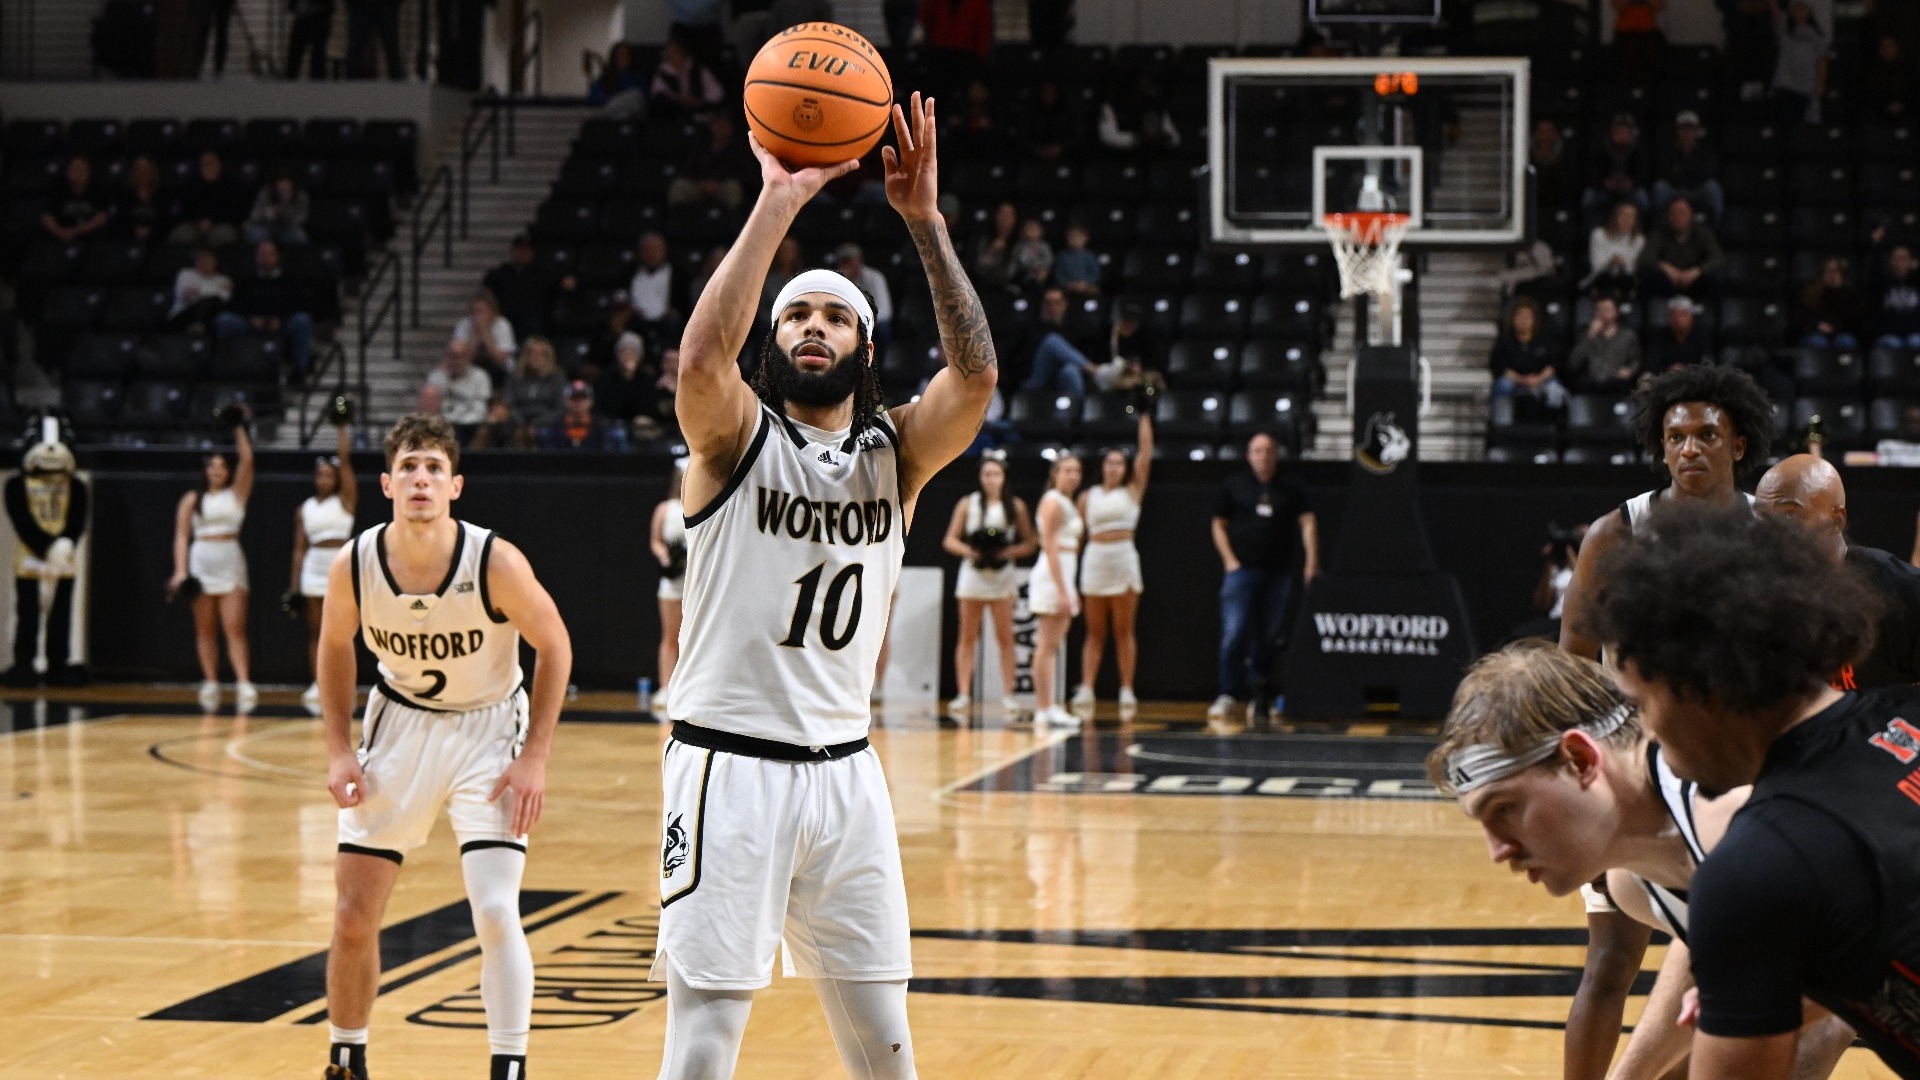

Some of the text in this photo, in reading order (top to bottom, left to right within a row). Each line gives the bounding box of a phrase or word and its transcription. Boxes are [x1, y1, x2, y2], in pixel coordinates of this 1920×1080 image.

[788, 50, 848, 76] EVO
[757, 486, 892, 546] WOFFORD
[777, 560, 864, 651] 10
[368, 625, 484, 660] WOFFORD
[1313, 612, 1449, 640] WOFFORD
[1320, 637, 1440, 656] BASKETBALL
[413, 669, 447, 702] 2
